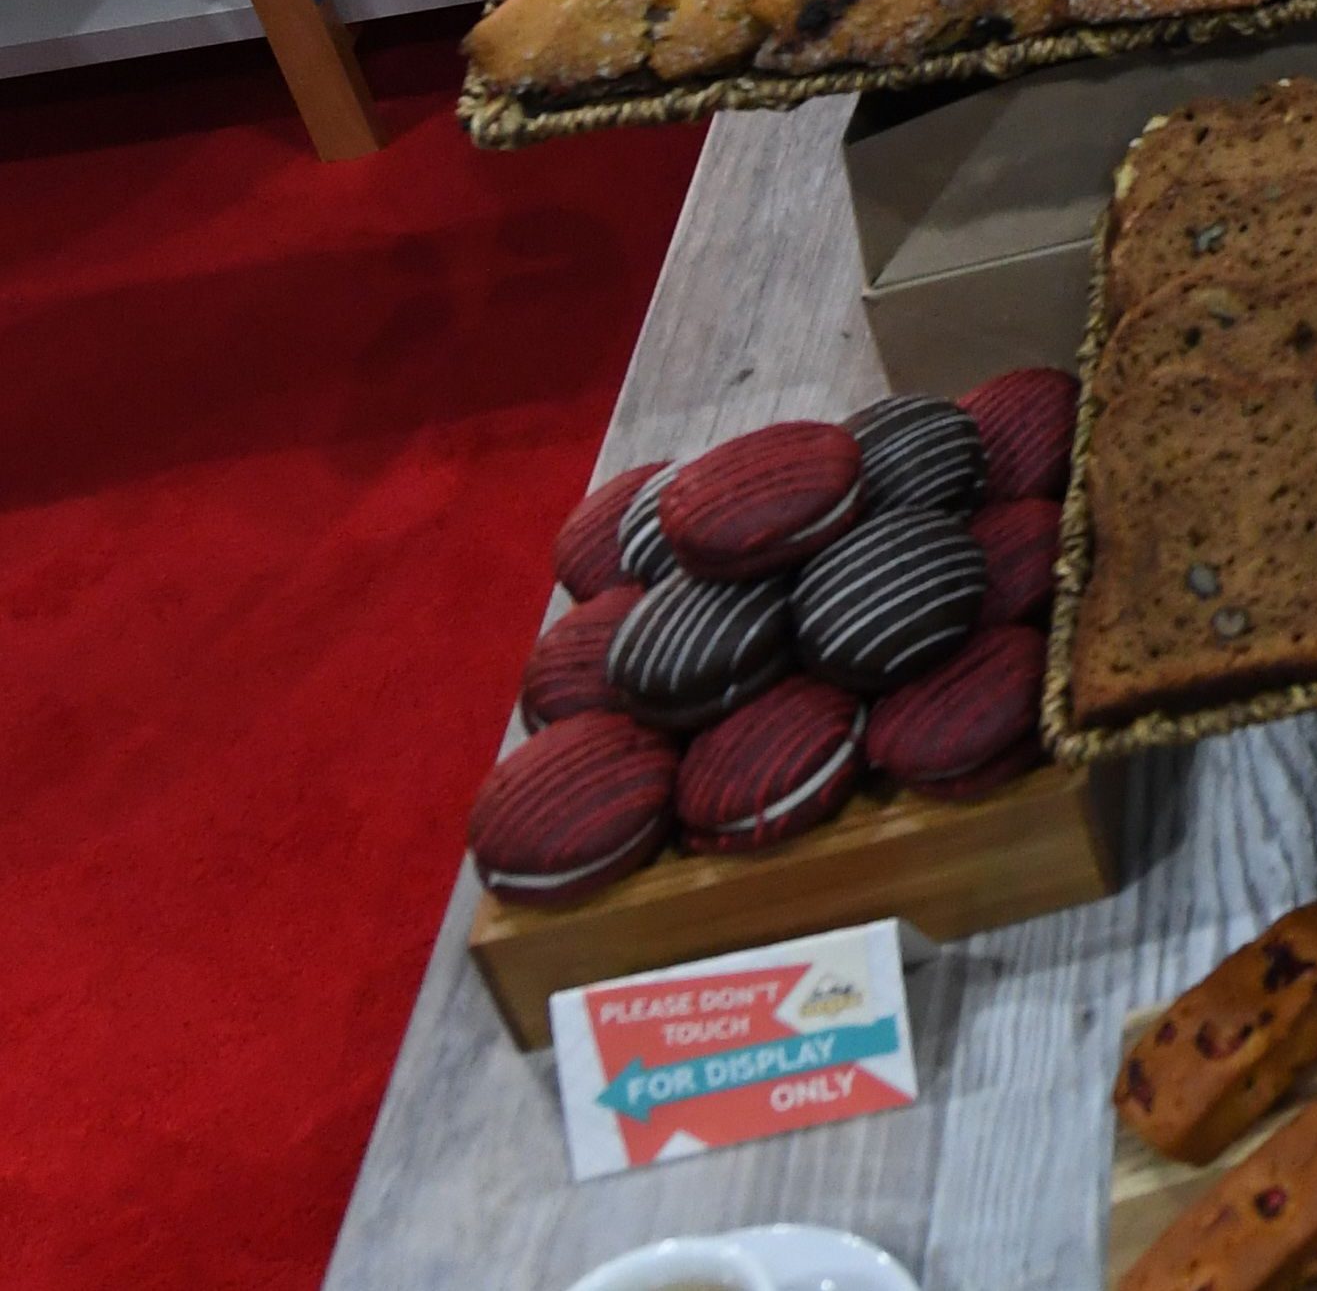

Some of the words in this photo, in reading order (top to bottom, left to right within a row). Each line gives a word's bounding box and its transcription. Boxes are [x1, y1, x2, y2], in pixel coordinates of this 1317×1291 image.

[601, 990, 695, 1026] PLEASE
[698, 981, 780, 1011] DON'T
[663, 1015, 751, 1046] TOUCH
[626, 1069, 696, 1107] FOR
[704, 1033, 837, 1086] DISPLAY
[769, 1070, 857, 1113] ONLY
